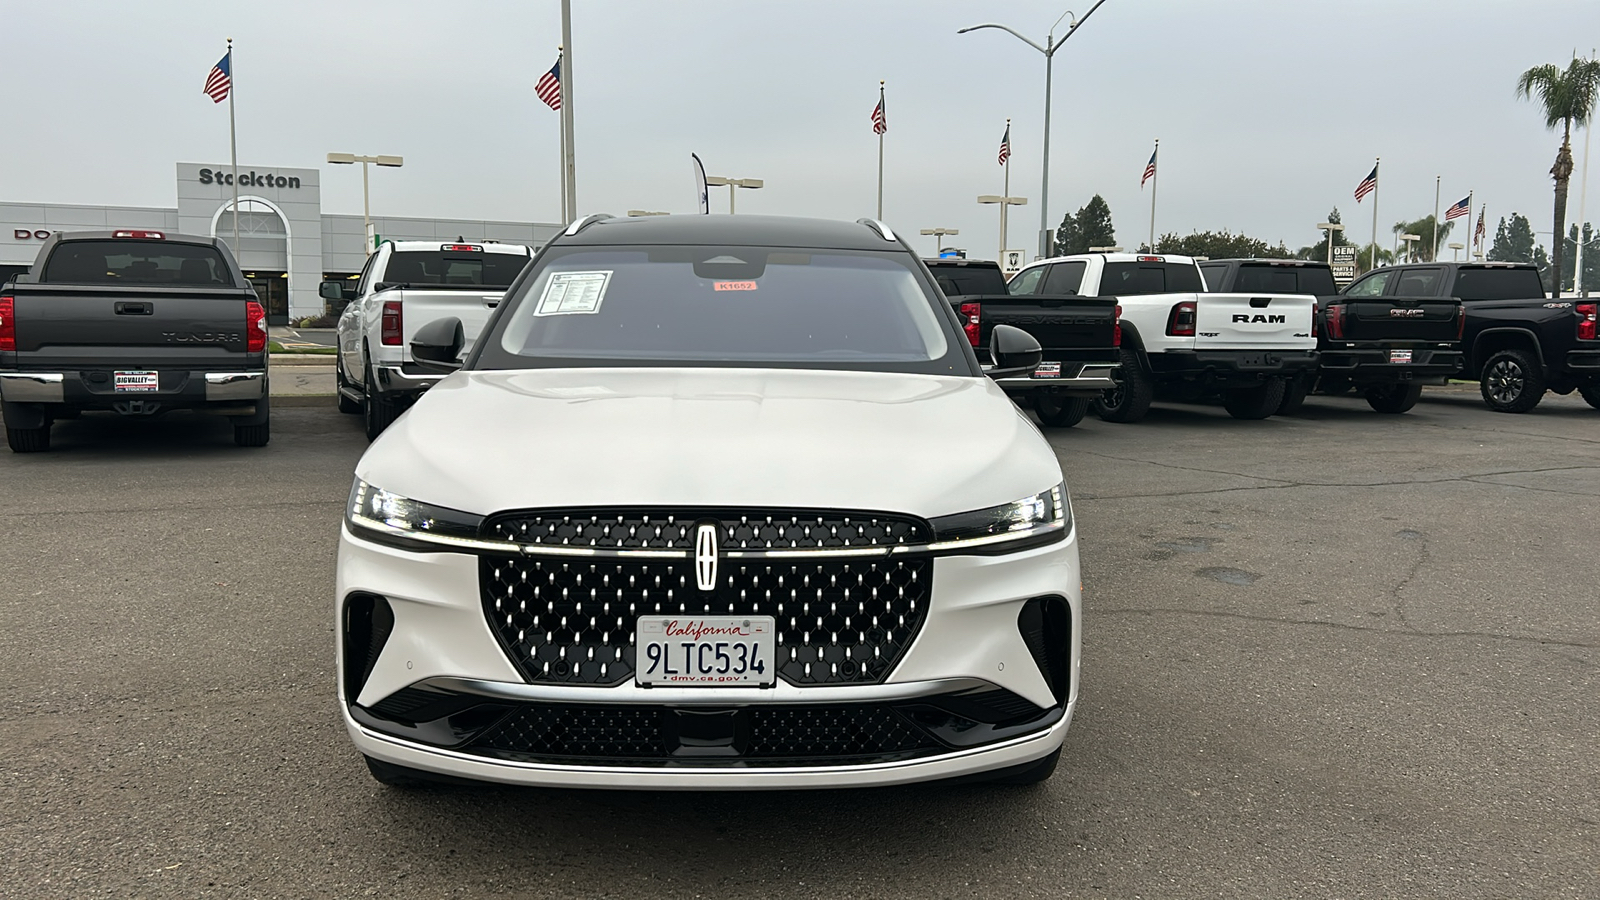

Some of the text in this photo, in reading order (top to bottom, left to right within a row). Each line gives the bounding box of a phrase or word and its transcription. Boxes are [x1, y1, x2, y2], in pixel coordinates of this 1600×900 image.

[199, 168, 301, 189] Stockton
[1232, 314, 1285, 323] RAM
[1390, 308, 1425, 318] GMC
[162, 332, 241, 342] TUNDRA
[666, 620, 749, 641] California
[646, 643, 765, 675] 9LTC534
